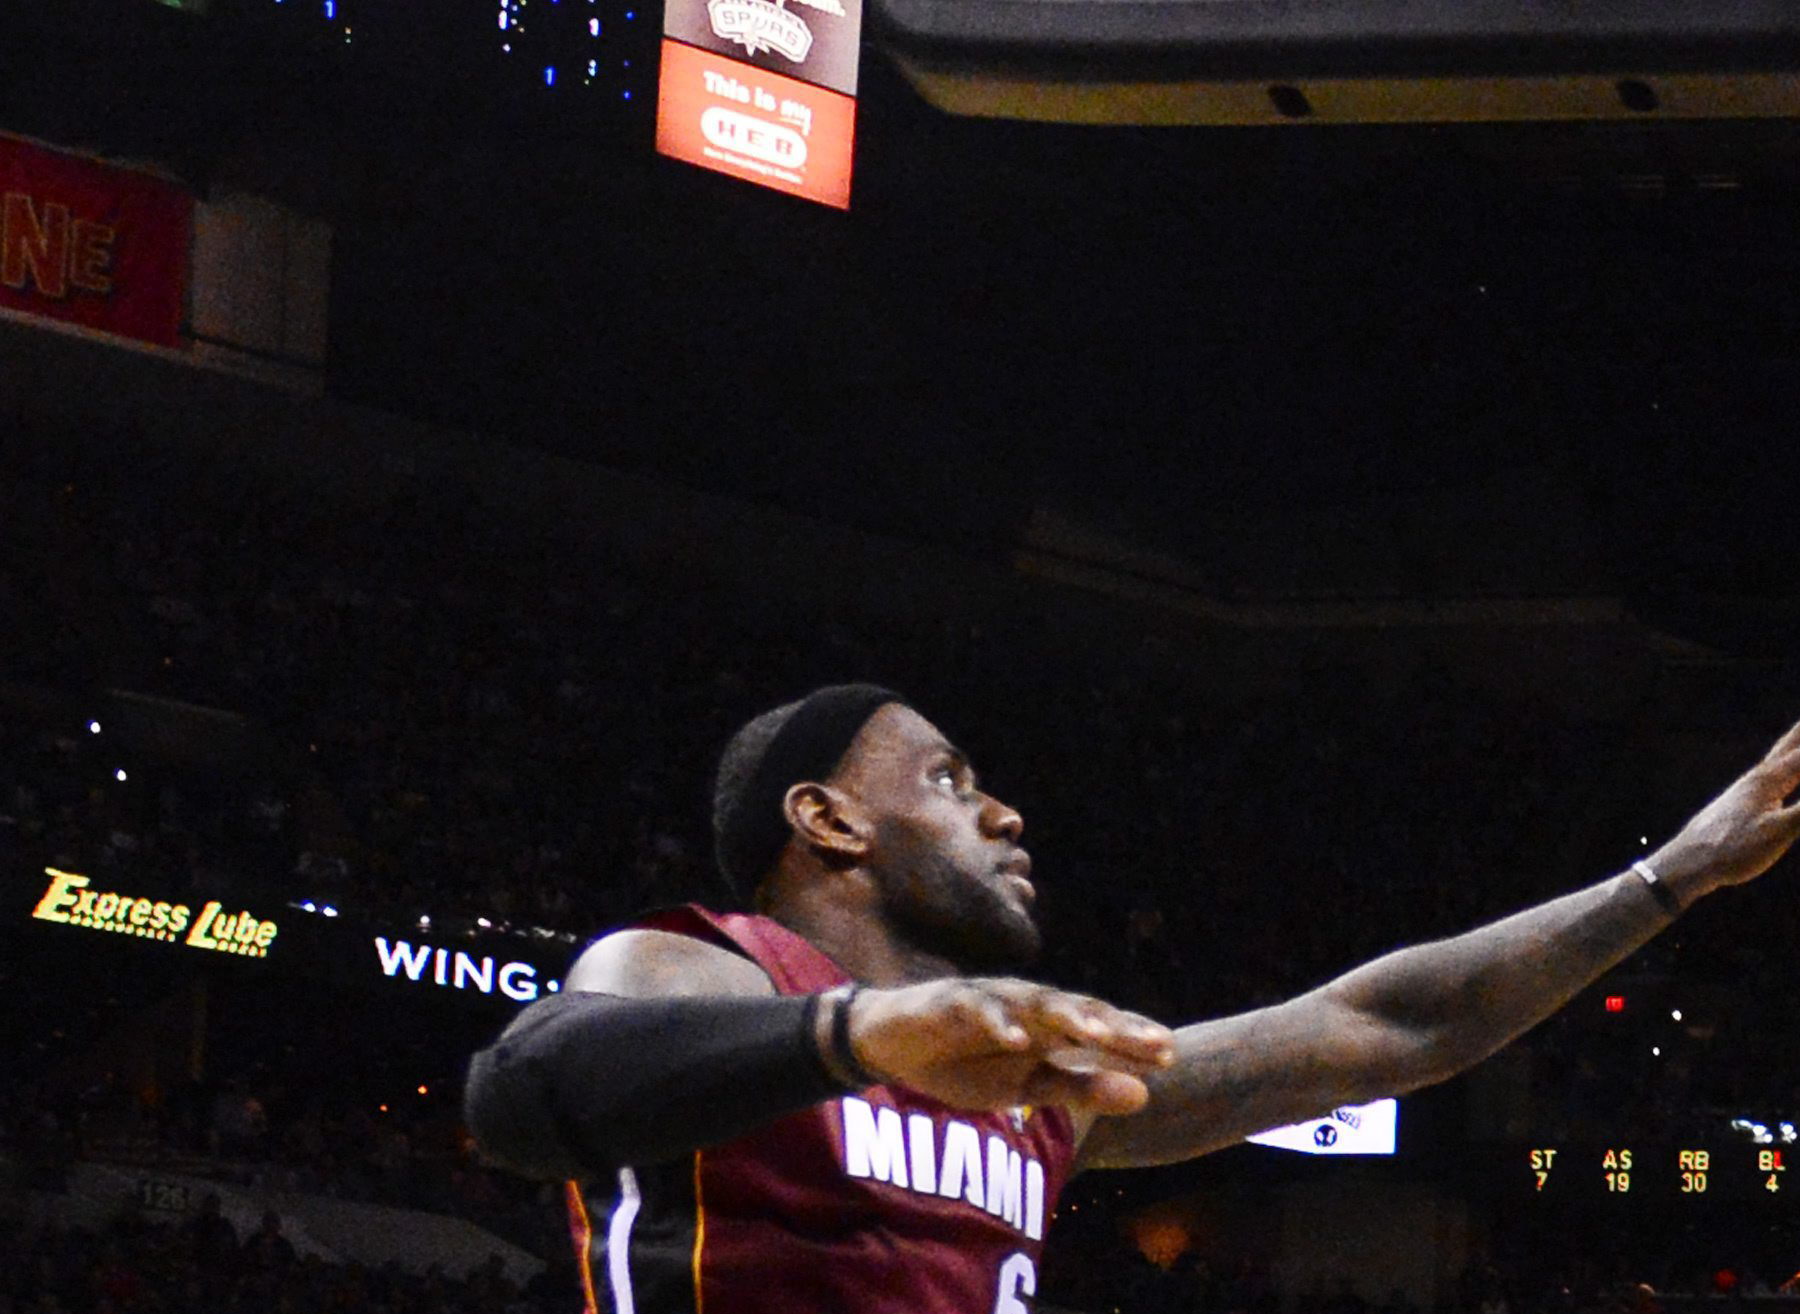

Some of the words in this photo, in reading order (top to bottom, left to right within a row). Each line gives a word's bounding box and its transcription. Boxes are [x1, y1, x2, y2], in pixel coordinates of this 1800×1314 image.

[703, 70, 749, 104] This
[754, 87, 777, 112] is
[32, 866, 190, 934] Express
[186, 900, 277, 950] Lube
[842, 1095, 1044, 1241] MIAMI
[1530, 1150, 1557, 1170] ST
[1603, 1150, 1632, 1170] AS
[1679, 1150, 1709, 1171] RB
[1758, 1150, 1785, 1171] BL
[1535, 1172, 1548, 1192] 7
[1605, 1172, 1630, 1192] 19
[1680, 1172, 1707, 1193] 30
[1765, 1173, 1779, 1193] 4
